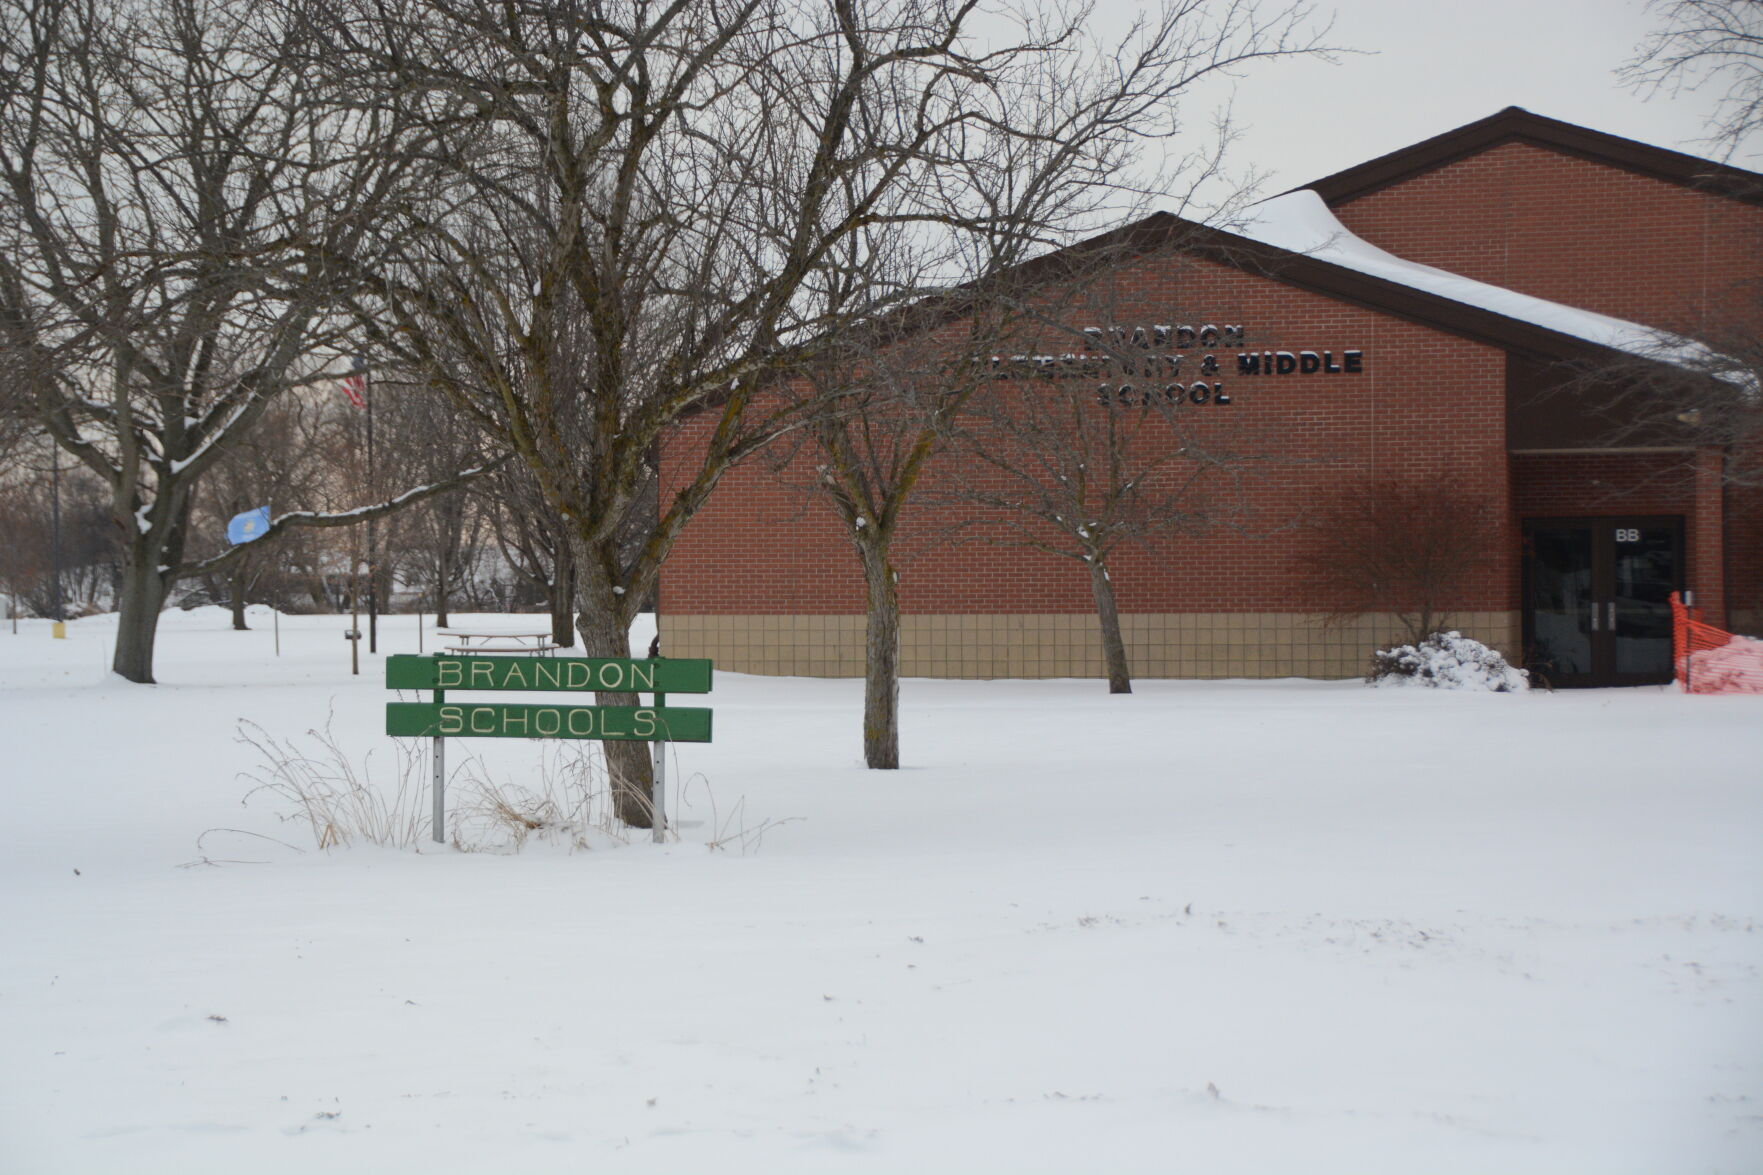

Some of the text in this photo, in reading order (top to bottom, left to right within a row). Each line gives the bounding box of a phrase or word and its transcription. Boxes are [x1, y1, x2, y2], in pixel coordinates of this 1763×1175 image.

[1200, 354, 1220, 376] &
[1237, 349, 1363, 375] MIDDLE
[1615, 528, 1640, 542] BB
[437, 660, 655, 689] BRANDON
[438, 706, 657, 737] SCHOOLS
